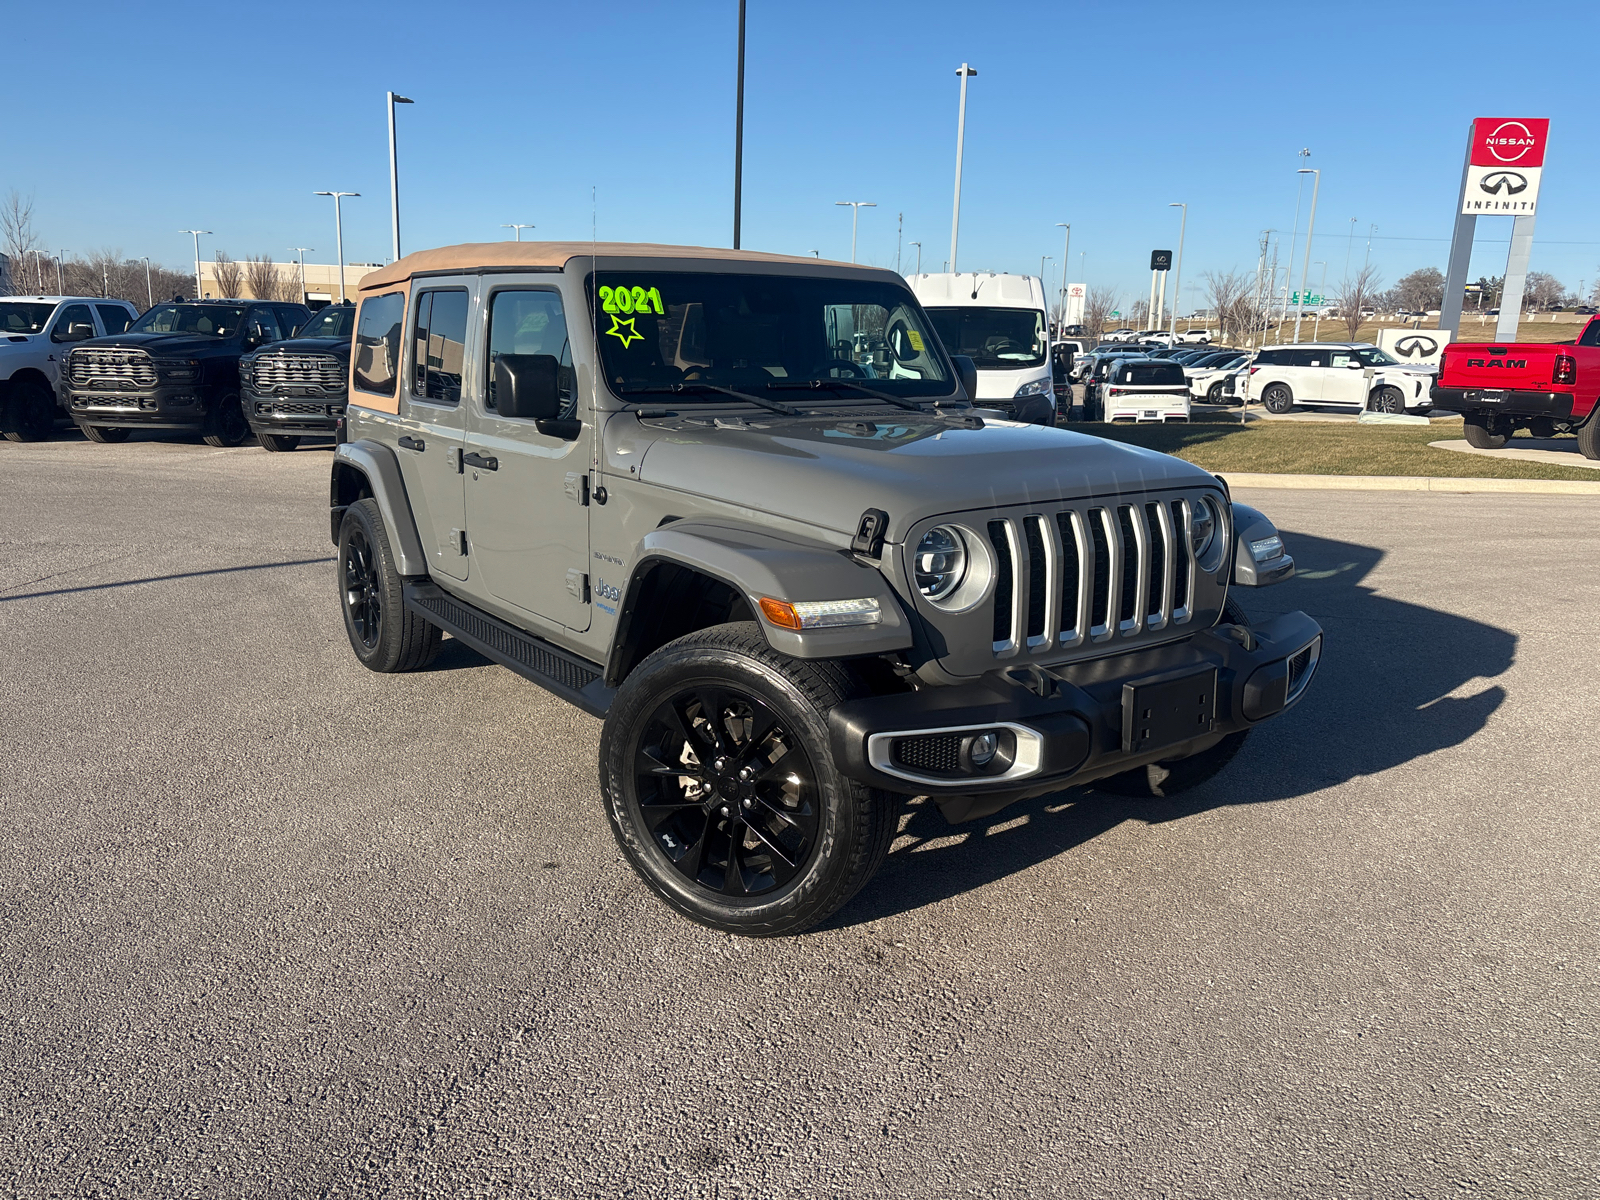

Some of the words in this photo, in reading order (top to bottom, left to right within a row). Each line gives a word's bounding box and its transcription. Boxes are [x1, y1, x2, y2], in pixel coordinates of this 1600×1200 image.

[1467, 201, 1534, 210] INFINITI
[599, 286, 665, 315] 2021
[1467, 358, 1527, 369] RAM
